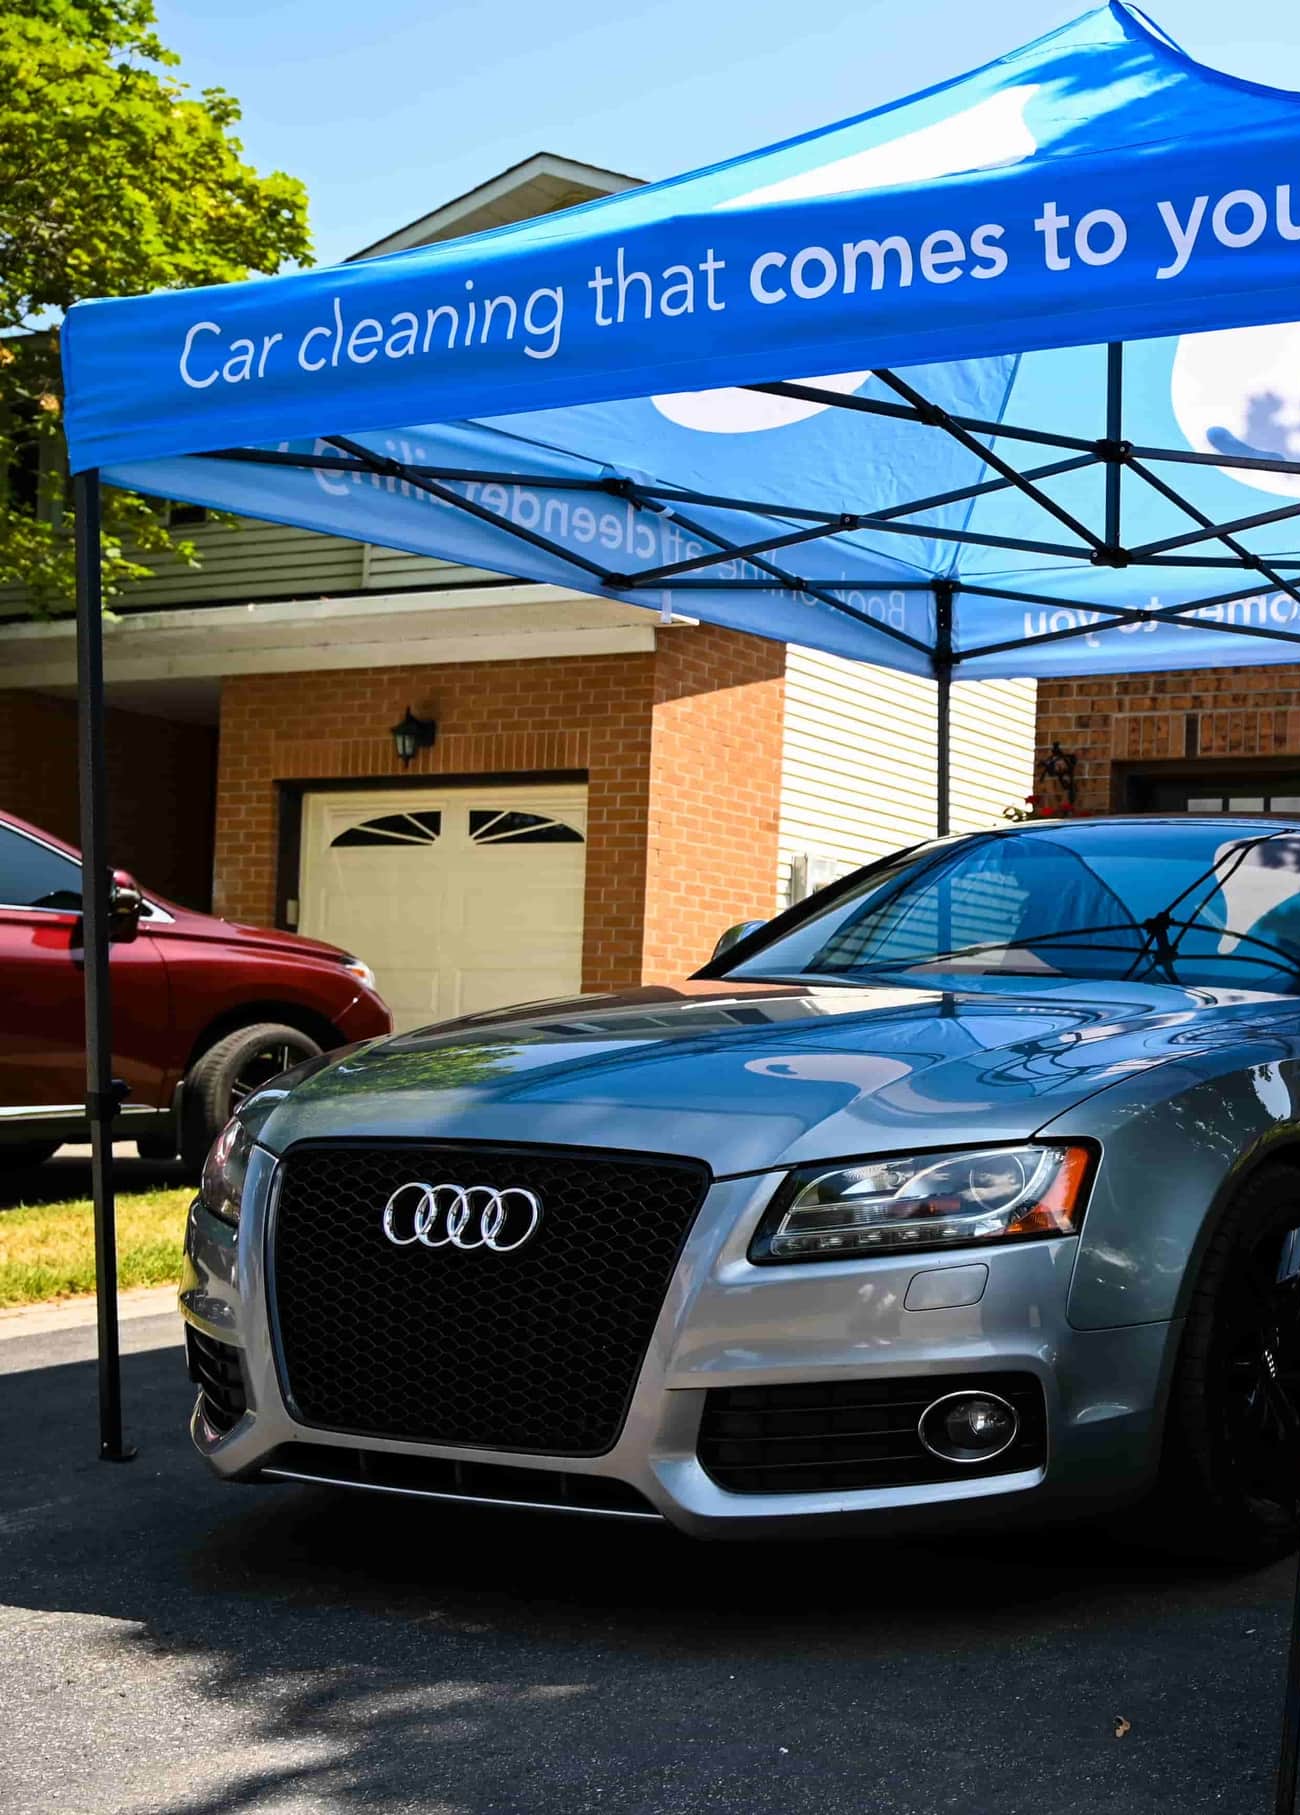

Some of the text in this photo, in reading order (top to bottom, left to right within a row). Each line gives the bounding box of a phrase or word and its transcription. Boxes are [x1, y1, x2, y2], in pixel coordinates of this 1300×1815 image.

[179, 321, 282, 390] Car
[298, 280, 564, 374] cleaning
[587, 247, 726, 327] that
[749, 222, 1008, 306] comes
[1034, 200, 1127, 272] to
